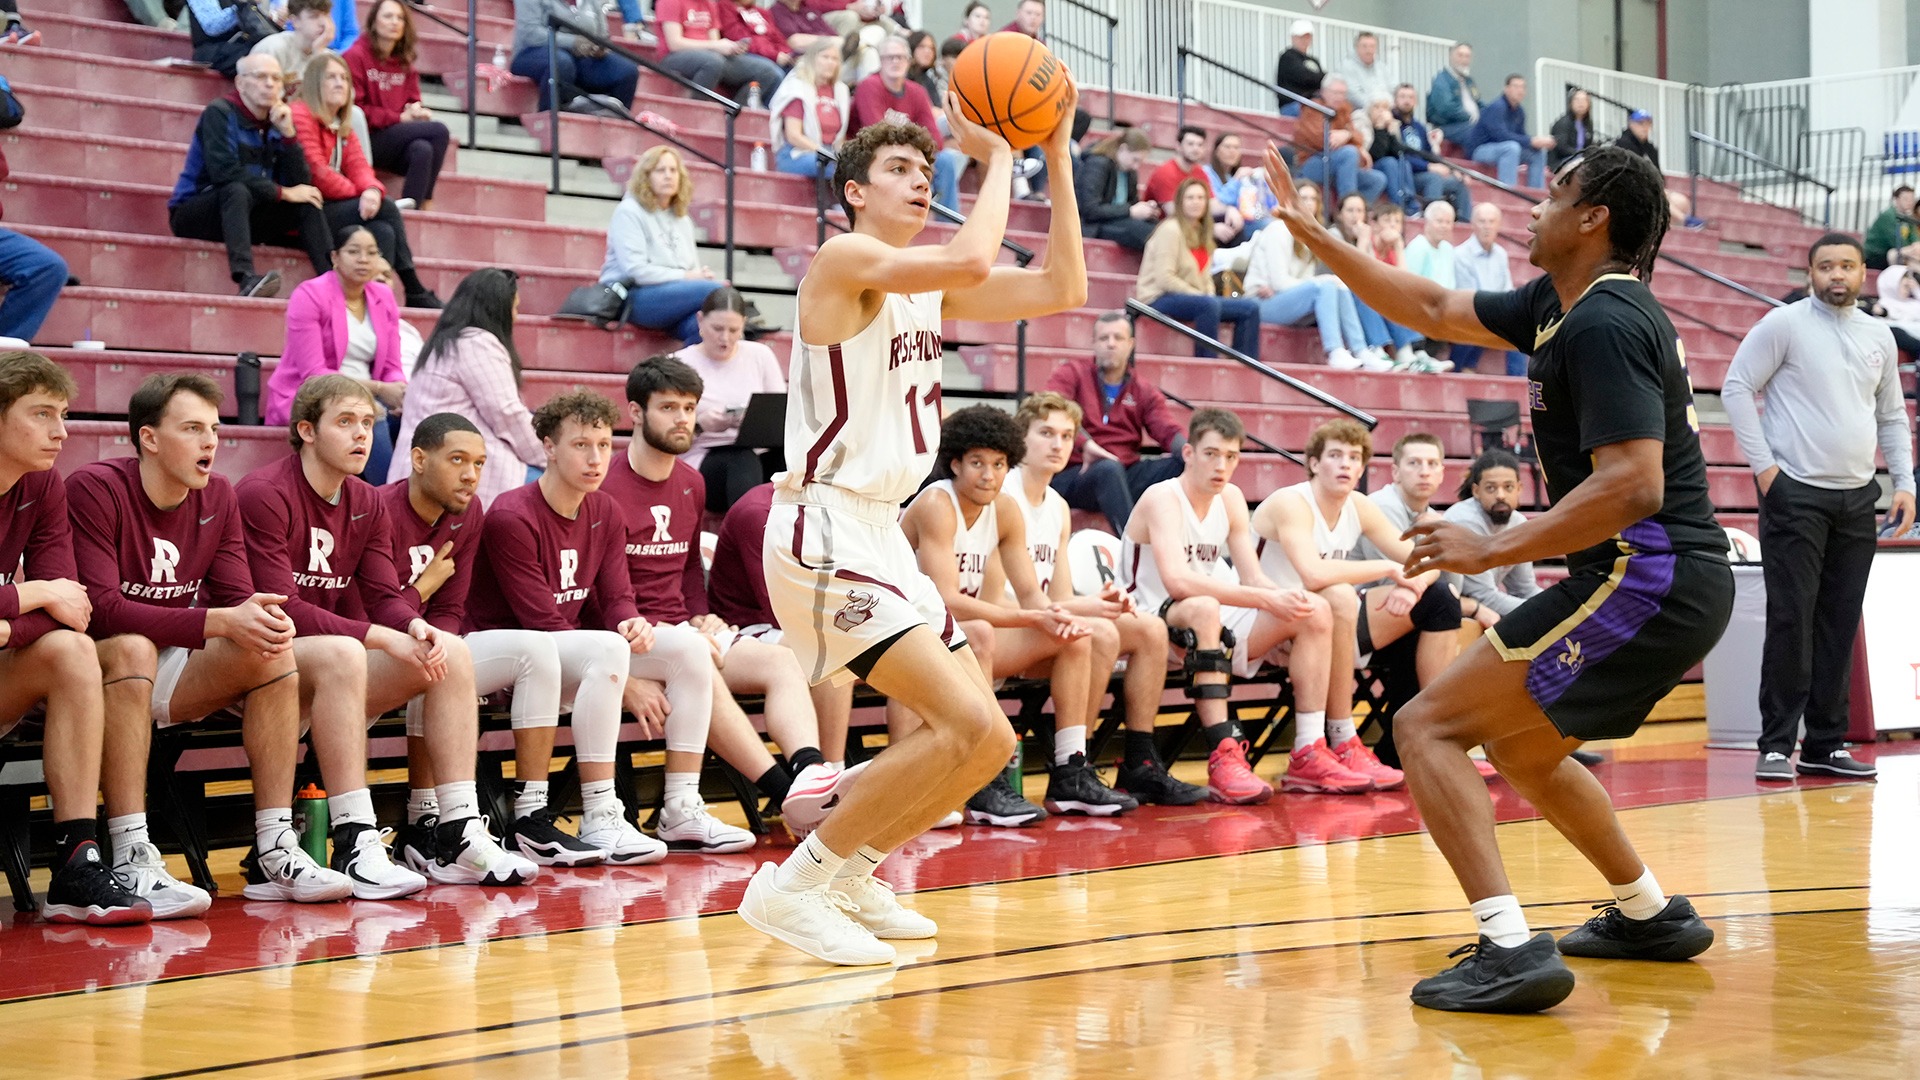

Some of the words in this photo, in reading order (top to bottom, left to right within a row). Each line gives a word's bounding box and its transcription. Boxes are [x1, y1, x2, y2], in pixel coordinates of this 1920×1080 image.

[905, 381, 942, 454] 11
[650, 505, 673, 542] R
[151, 537, 181, 583] R
[308, 527, 334, 573] R
[559, 549, 578, 590] R
[624, 541, 689, 556] BASKETBALL
